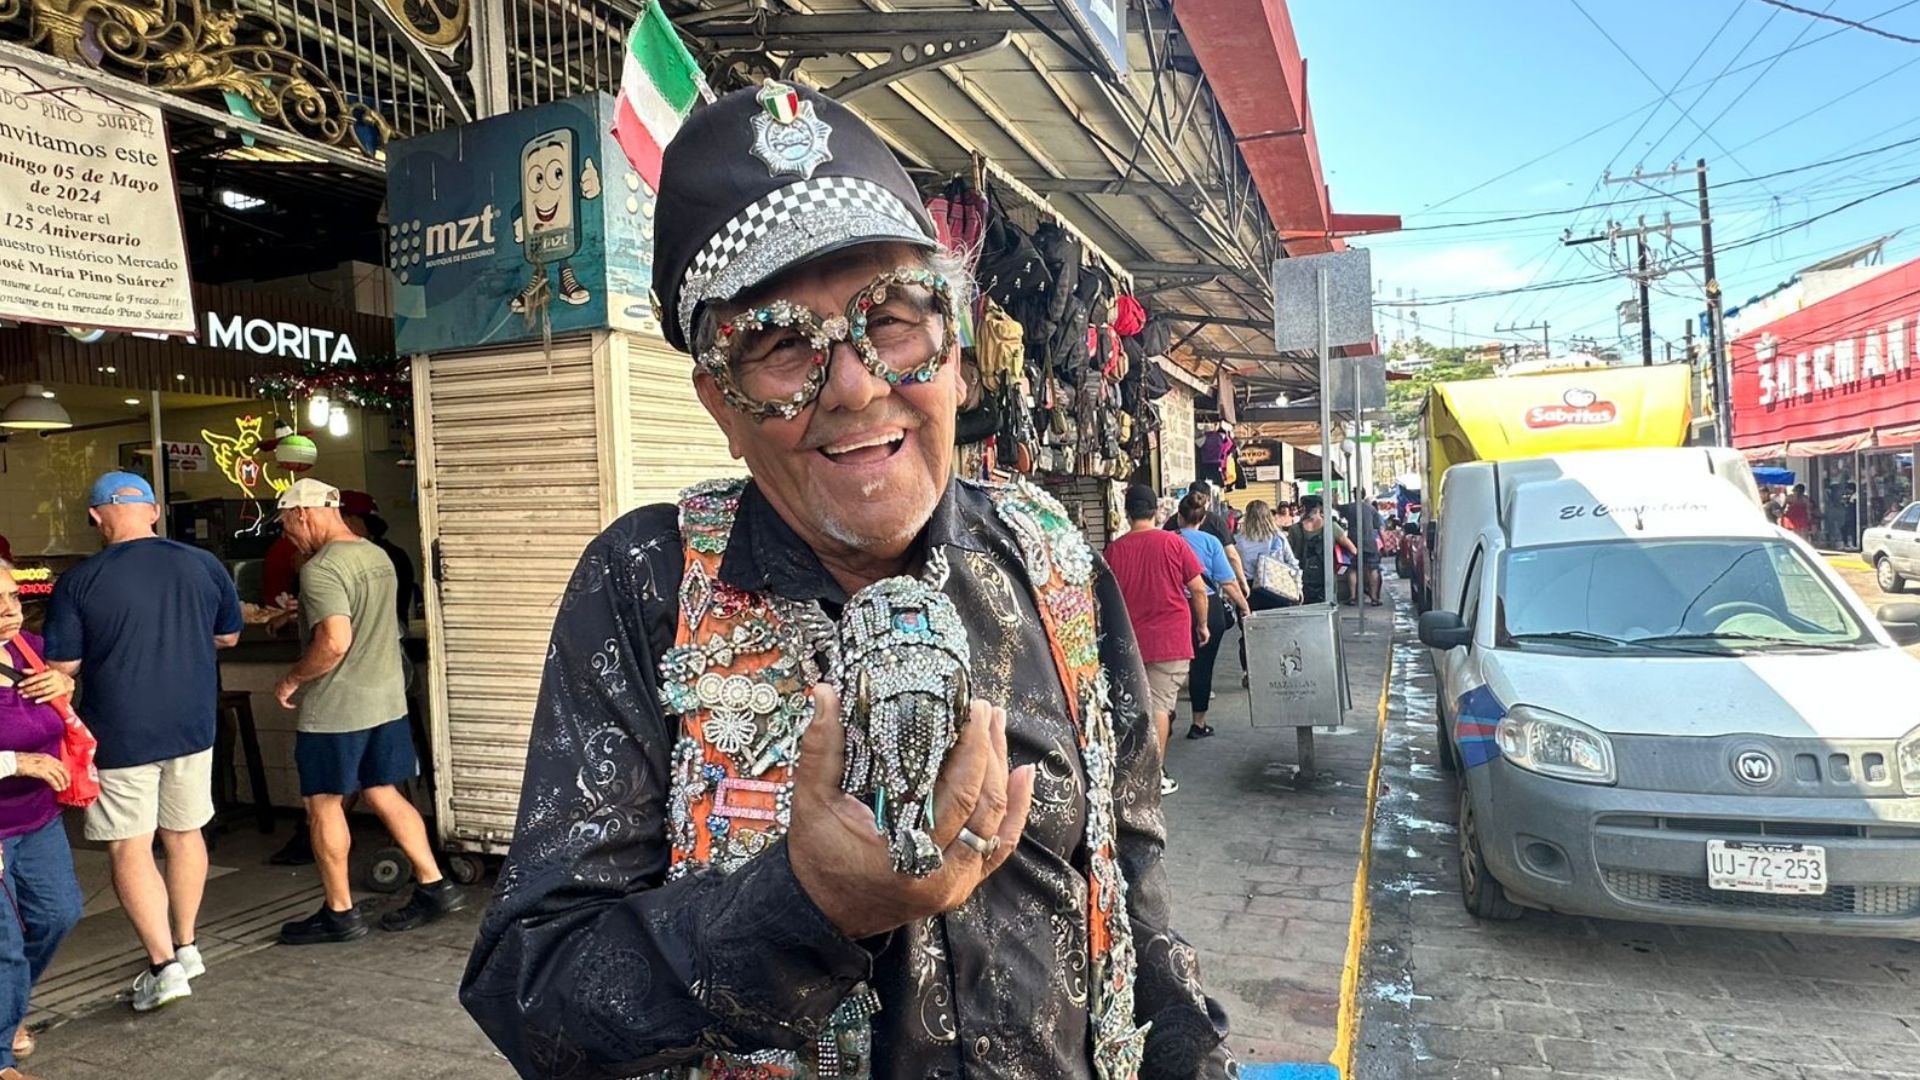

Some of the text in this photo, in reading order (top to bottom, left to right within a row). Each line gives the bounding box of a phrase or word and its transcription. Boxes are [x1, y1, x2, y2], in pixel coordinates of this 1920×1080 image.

[0, 90, 28, 110] DO
[41, 102, 83, 123] PINO
[115, 147, 158, 167] este
[53, 164, 75, 180] 05
[81, 168, 104, 183] de
[110, 171, 158, 193] Mayo
[30, 179, 101, 204] de 2024
[26, 202, 111, 225] a celebrar el
[5, 212, 141, 247] 125 Aniversario
[425, 204, 496, 257] mzt
[49, 244, 114, 264] Histórico
[117, 253, 178, 270] Mercado
[0, 258, 24, 271] osé
[28, 260, 75, 279] María
[78, 269, 113, 284] Pino
[34, 283, 65, 298] Local,
[67, 288, 112, 301] Consume
[115, 292, 125, 303] lo
[41, 301, 54, 309] en
[57, 302, 69, 311] tu
[72, 304, 115, 316] mercado
[117, 307, 142, 318] Pino
[208, 311, 357, 364] MORITA
[1531, 406, 1613, 424] Sabritas
[165, 443, 202, 457] AJA
[1559, 505, 1585, 520] El
[1712, 852, 1821, 880] UJ-72-253
